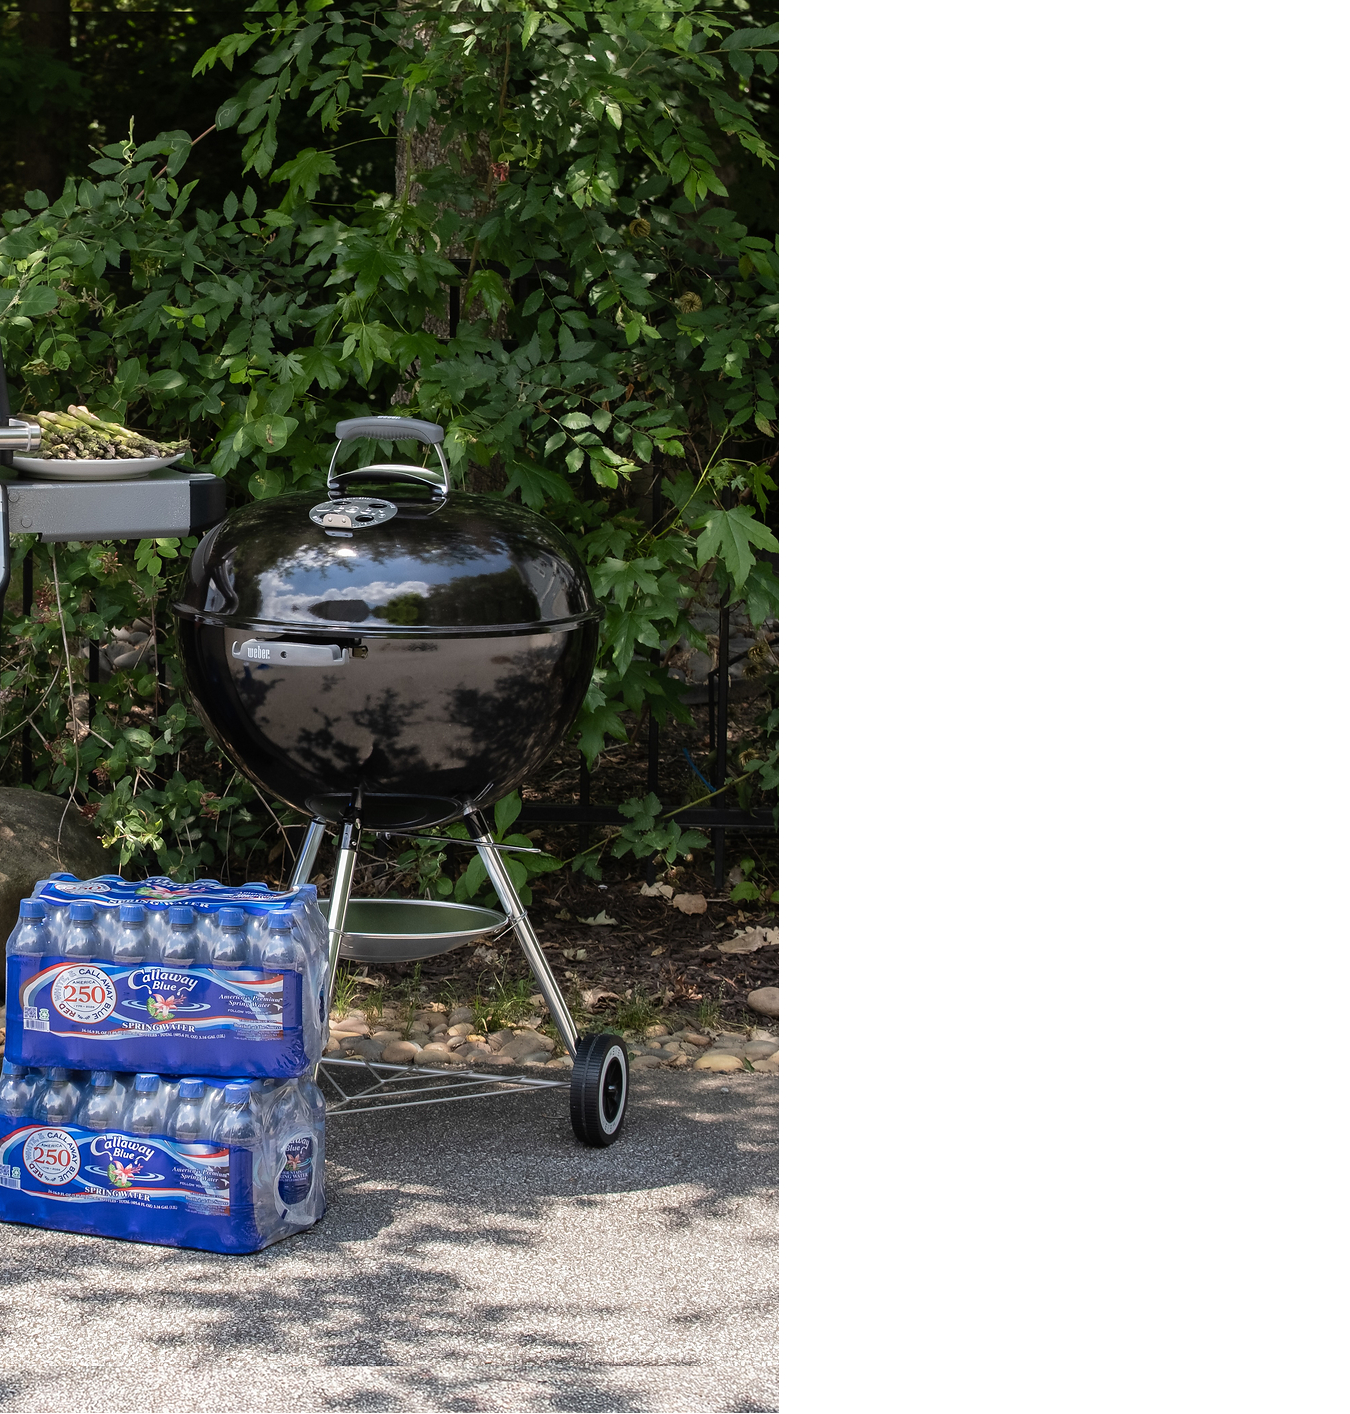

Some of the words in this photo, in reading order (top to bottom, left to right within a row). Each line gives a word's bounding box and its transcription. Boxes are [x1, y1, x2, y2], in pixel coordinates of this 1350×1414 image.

[78, 968, 114, 1000] CALLAWAY
[128, 968, 198, 991] Callaway
[152, 981, 177, 991] Blue
[63, 985, 106, 1004] 250
[92, 1002, 111, 1020] BLUE
[122, 1022, 159, 1031] SPRING
[159, 1023, 196, 1033] WATER
[33, 1146, 71, 1167] 250
[46, 1131, 78, 1165] CALLAWAY
[90, 1135, 155, 1161] Callaway
[113, 1148, 135, 1160] Blue
[58, 1165, 76, 1182] BLUE
[85, 1186, 118, 1197] SPRING
[118, 1189, 151, 1202] WATER
